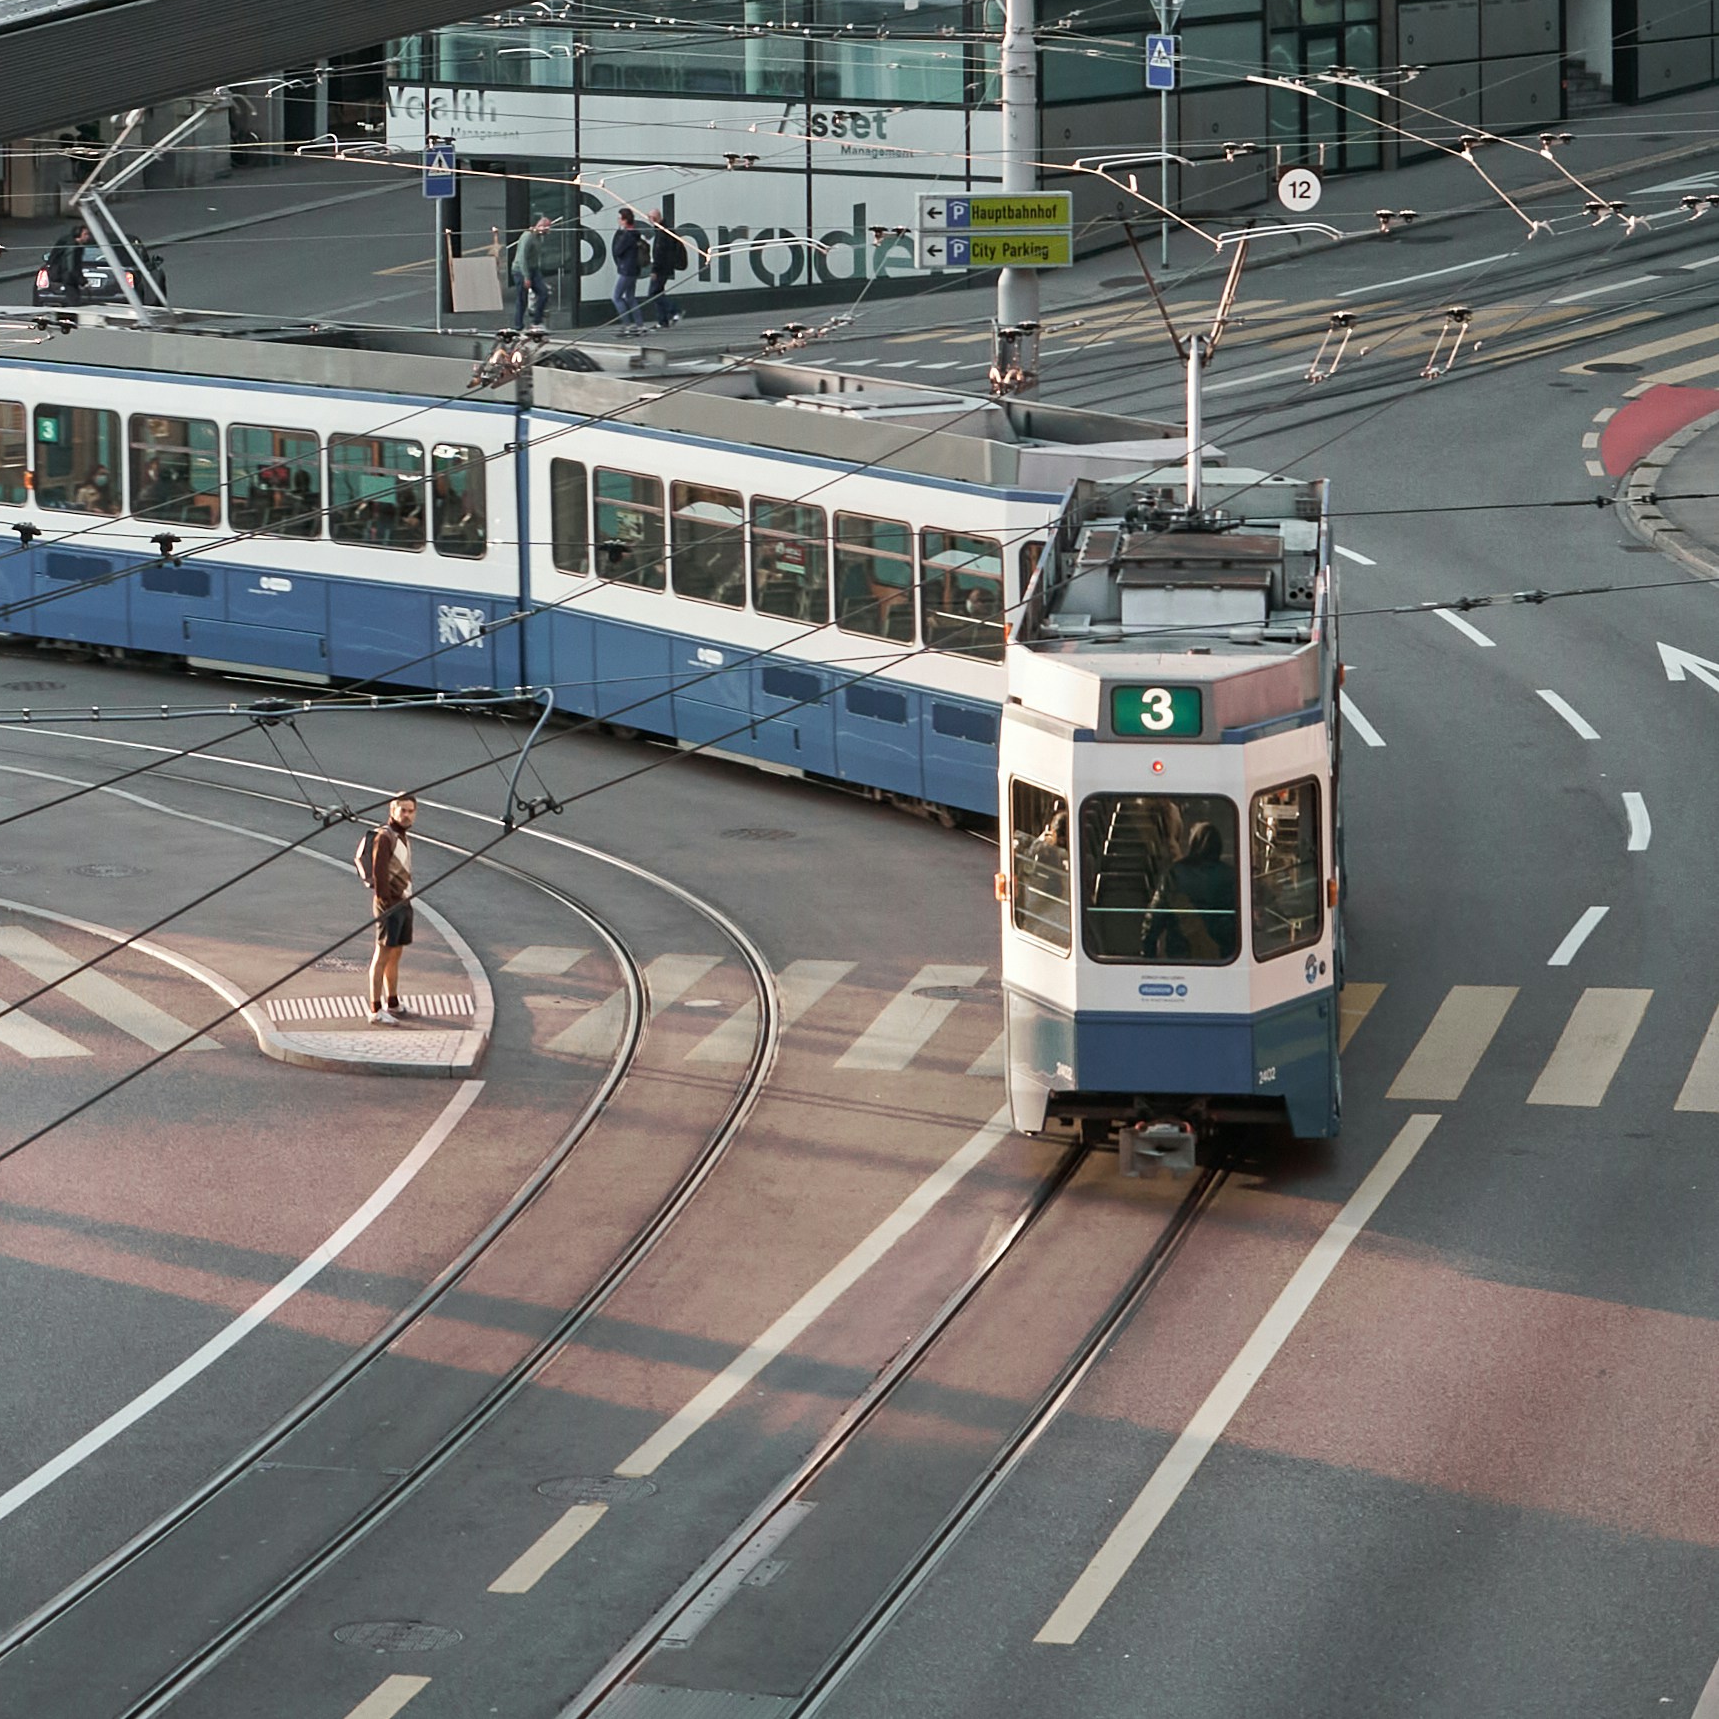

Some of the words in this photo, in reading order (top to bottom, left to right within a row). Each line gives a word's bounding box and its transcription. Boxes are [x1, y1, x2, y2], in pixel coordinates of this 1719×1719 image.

[840, 144, 915, 160] Management
[1288, 180, 1312, 199] 12
[971, 203, 1058, 223] Hauptbahnhof
[971, 241, 997, 261] City
[1002, 241, 1050, 261] Parking
[41, 419, 56, 439] 3
[1140, 687, 1174, 731] 3
